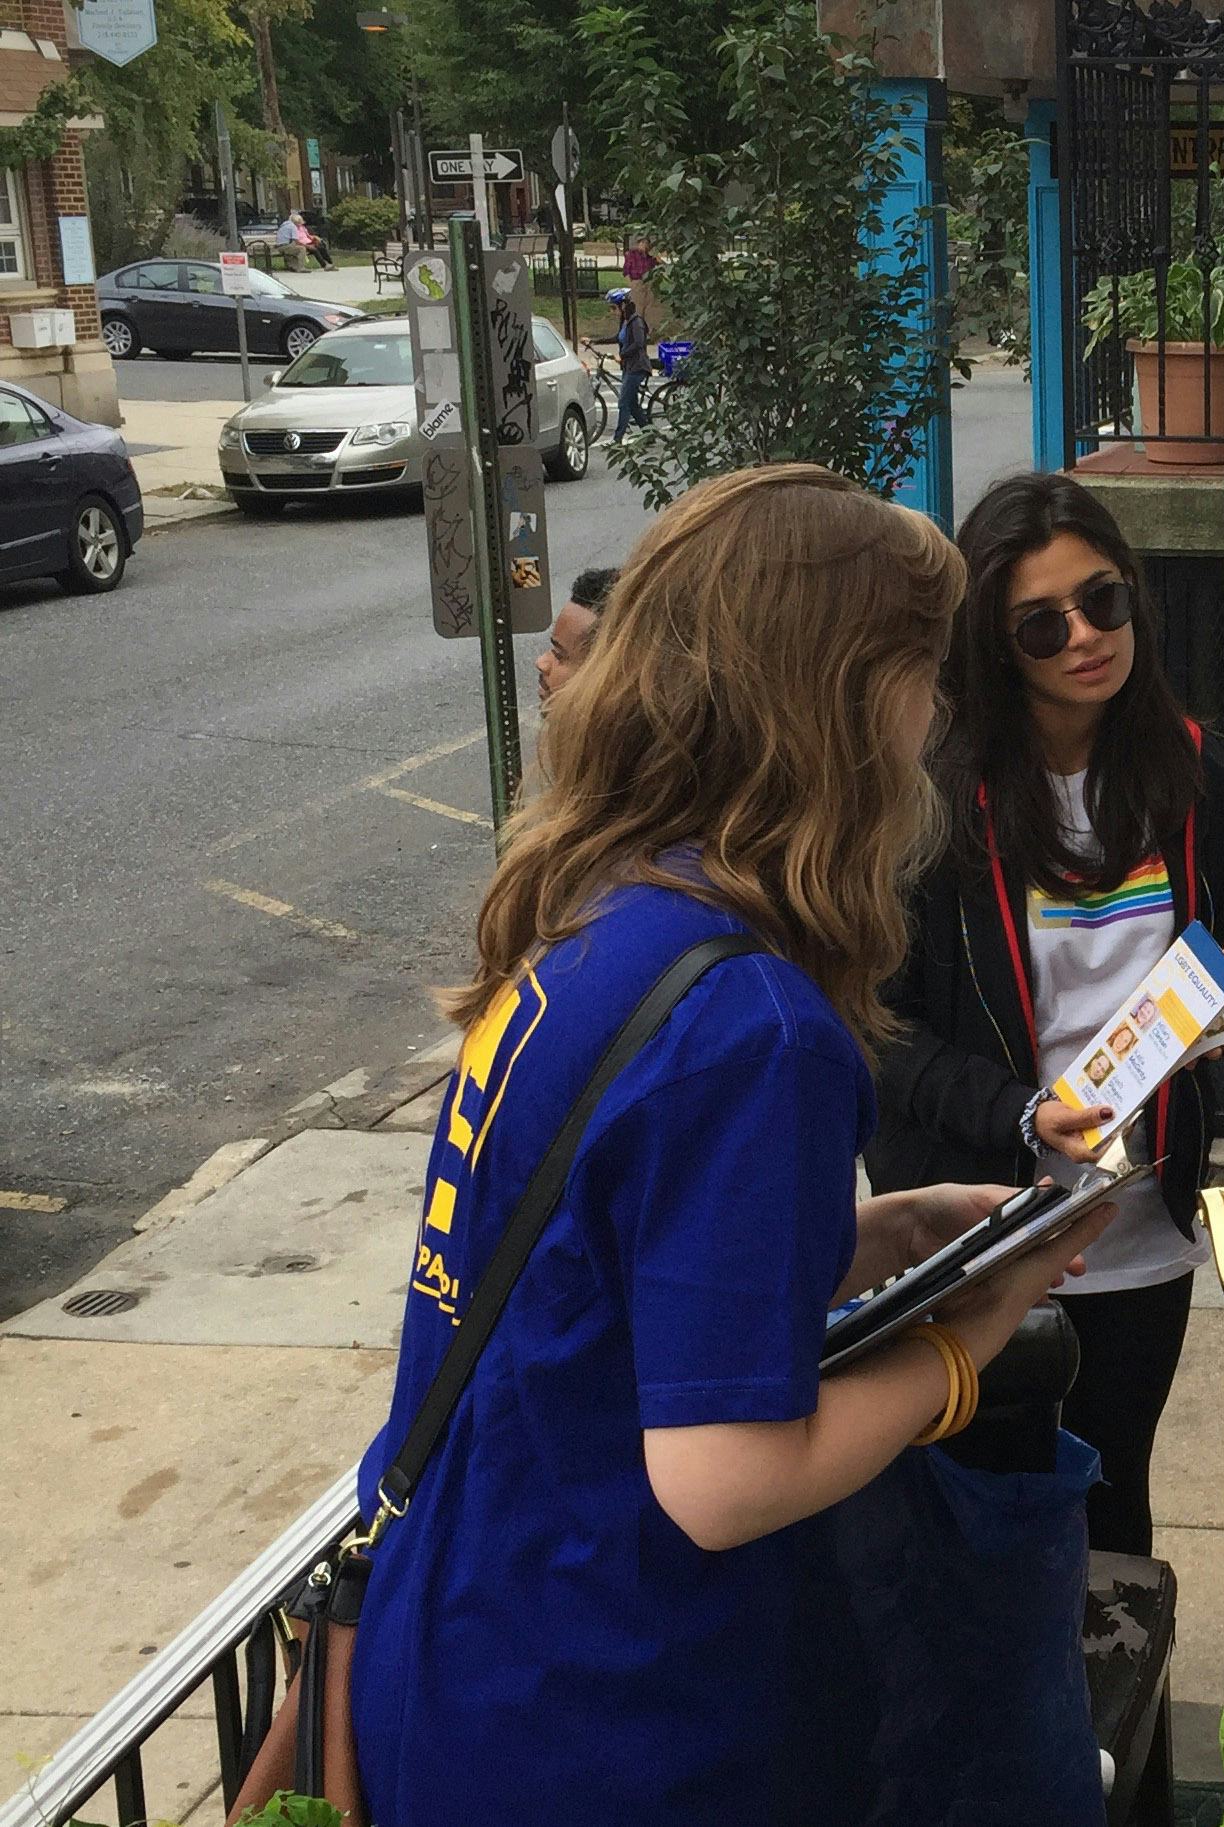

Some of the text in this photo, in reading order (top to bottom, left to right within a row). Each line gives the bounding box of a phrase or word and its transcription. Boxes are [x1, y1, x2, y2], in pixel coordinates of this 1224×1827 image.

[440, 160, 494, 173] ONE AY
[423, 403, 453, 438] blame
[1174, 953, 1190, 972] LGBT
[1188, 971, 1218, 1008] EQUALITY
